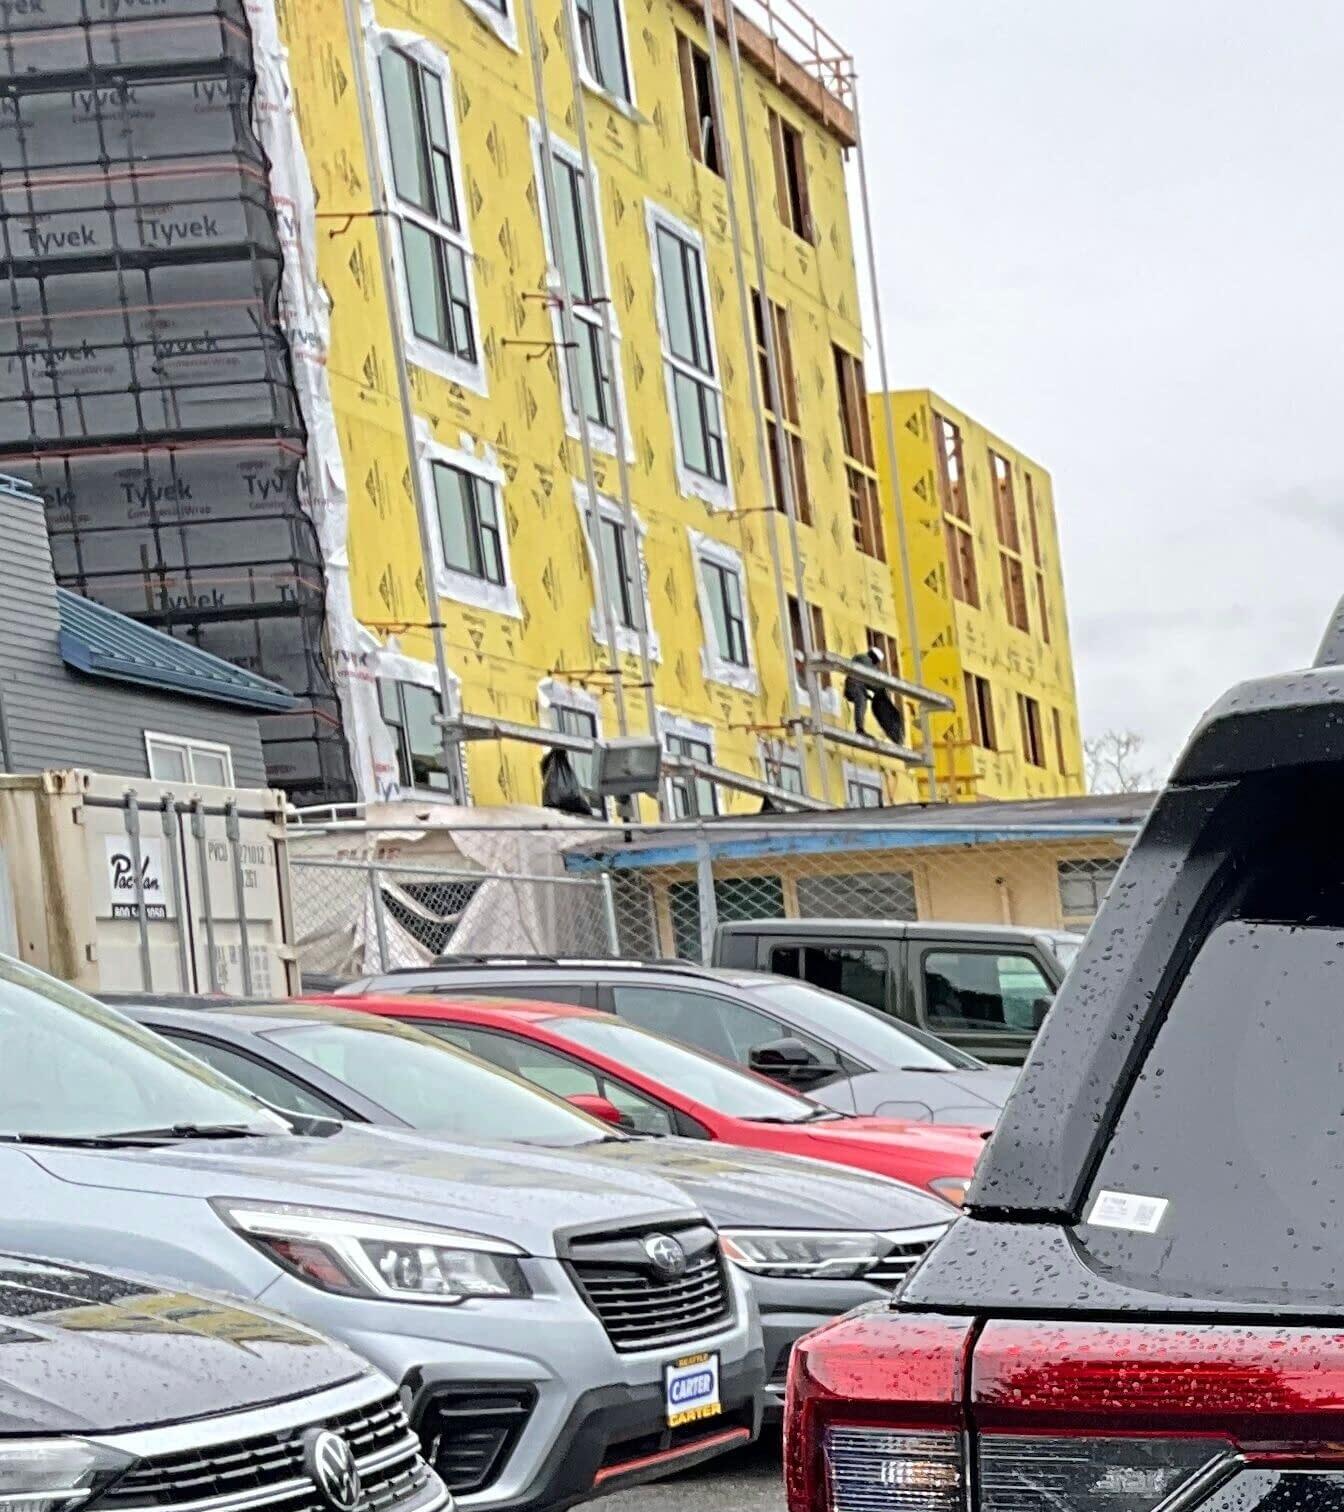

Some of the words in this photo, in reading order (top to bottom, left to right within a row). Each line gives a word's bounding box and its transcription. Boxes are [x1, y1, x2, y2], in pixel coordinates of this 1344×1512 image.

[25, 224, 97, 251] Tyvek
[150, 215, 219, 244] Tyvek
[120, 479, 193, 508] Tyvek
[672, 1374, 711, 1401] CARTER
[669, 1403, 722, 1428] CARTER
